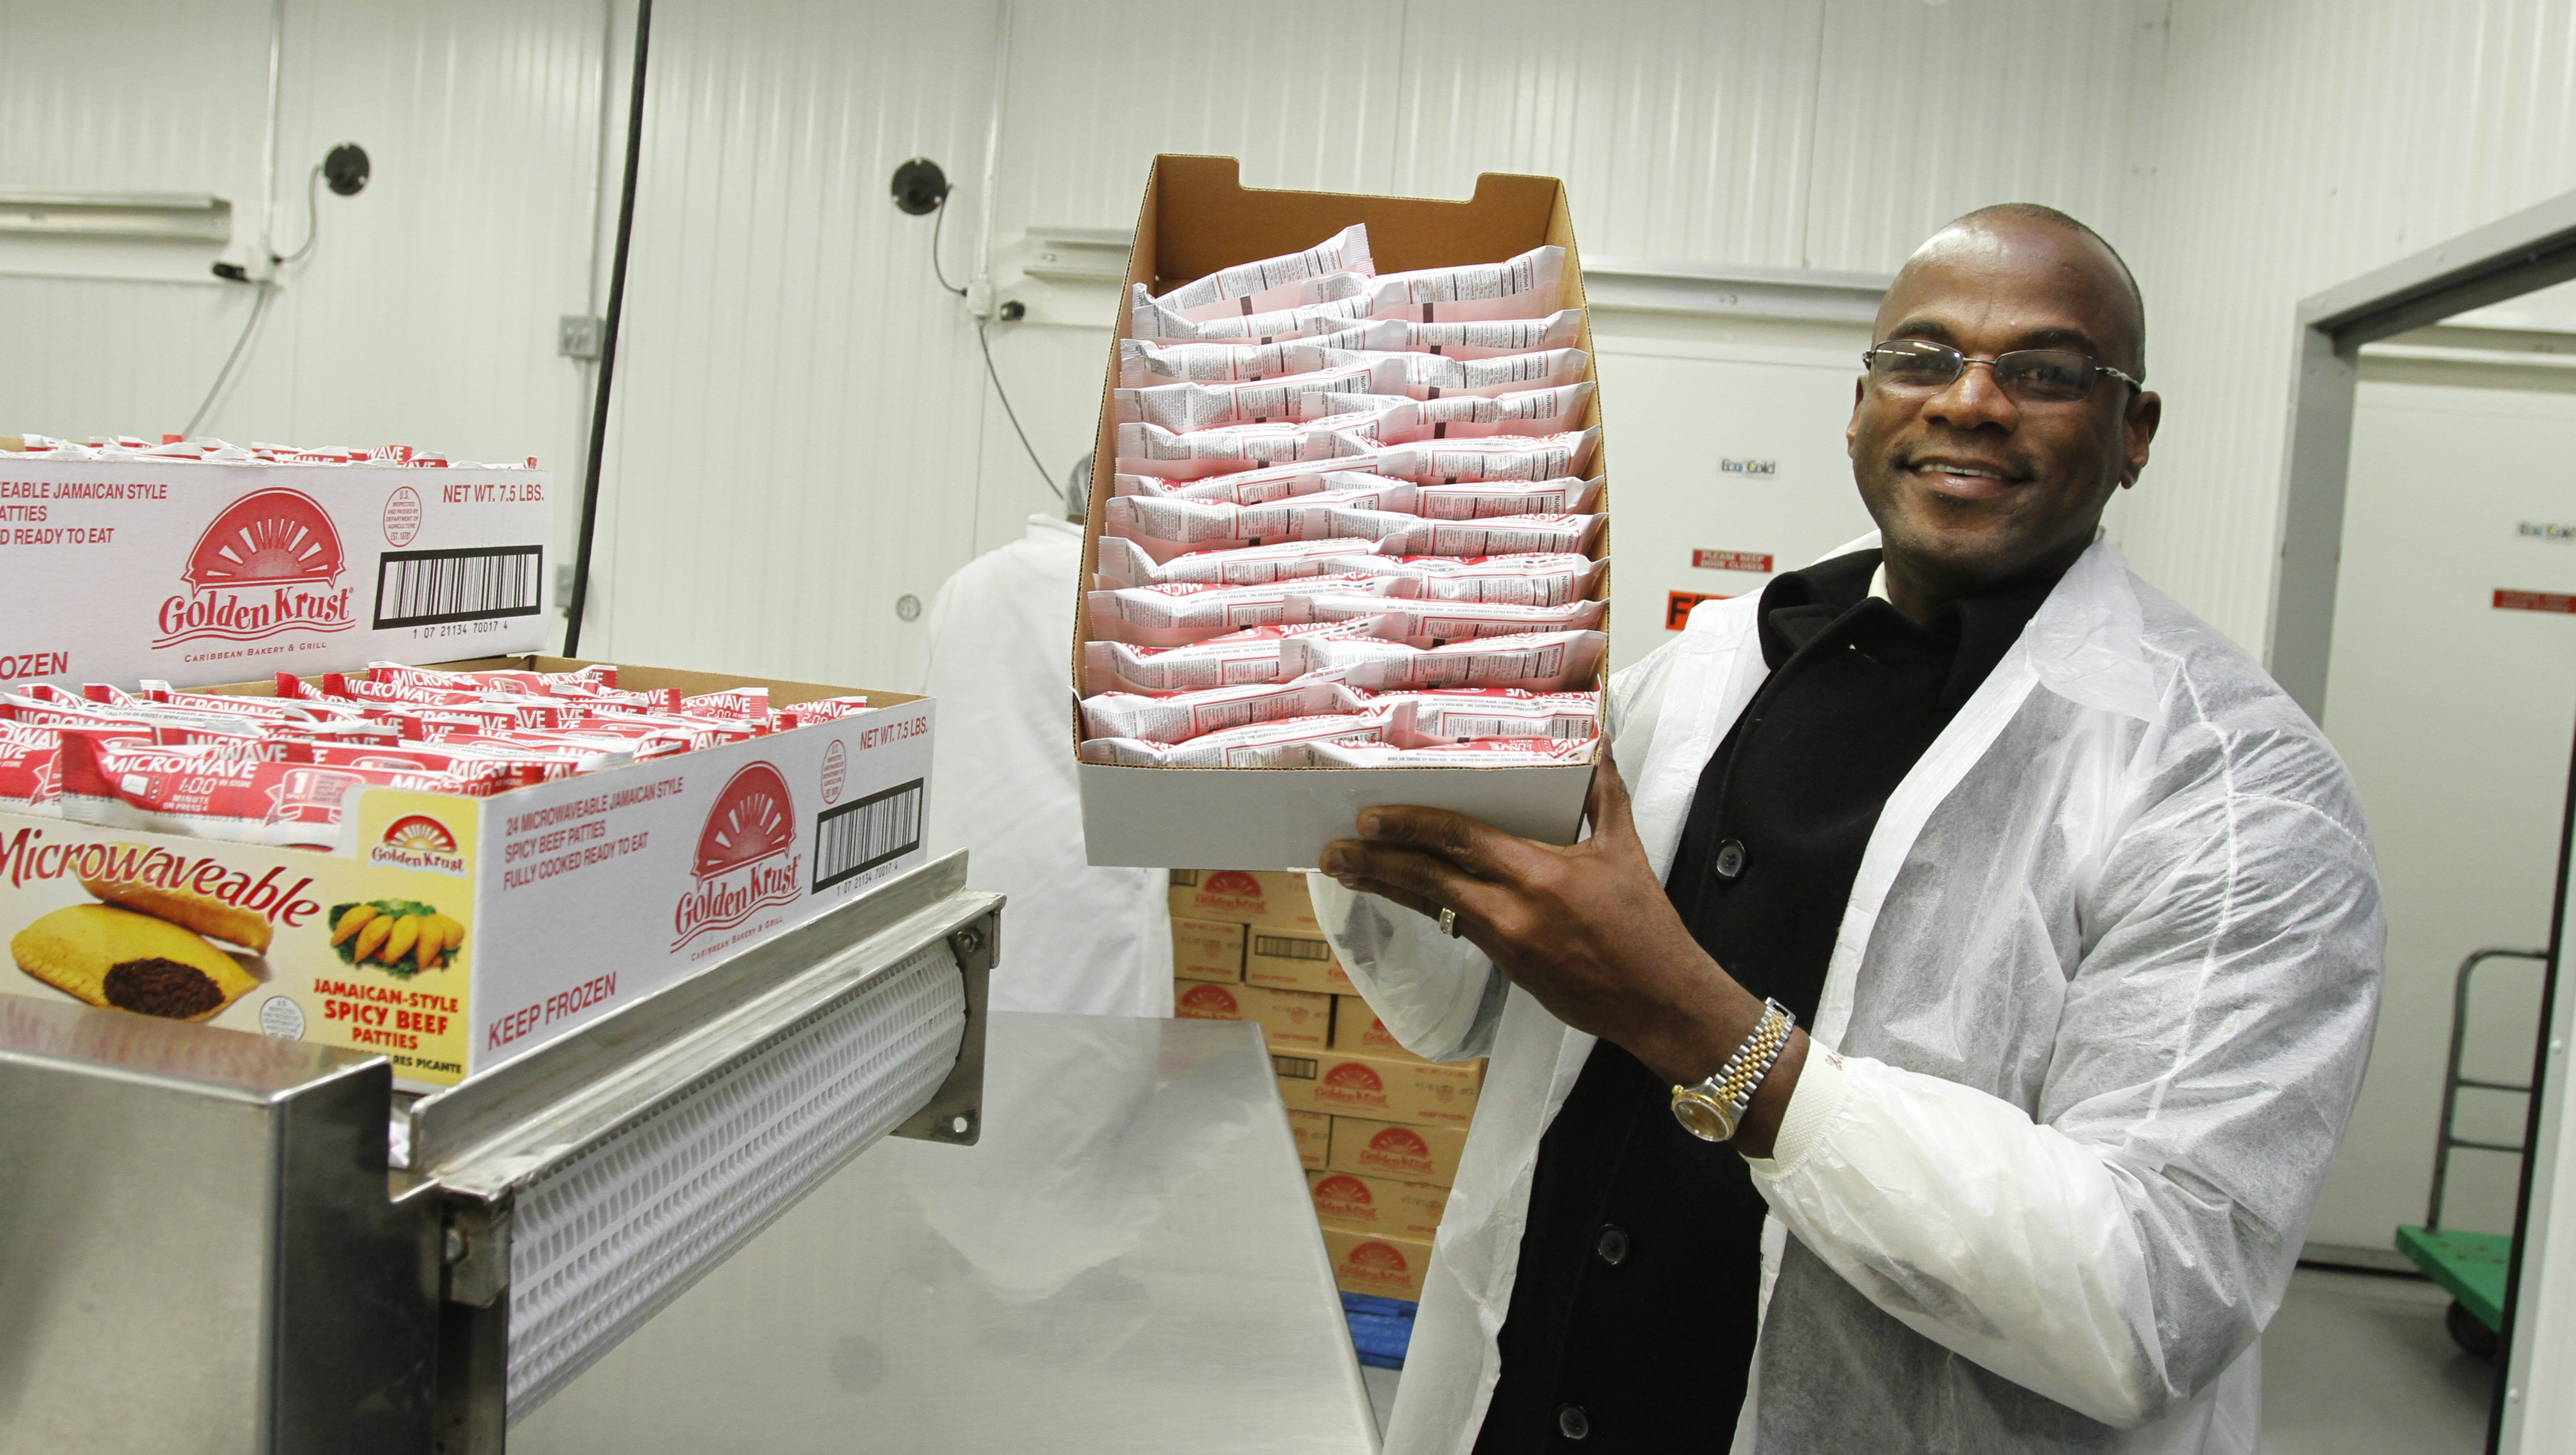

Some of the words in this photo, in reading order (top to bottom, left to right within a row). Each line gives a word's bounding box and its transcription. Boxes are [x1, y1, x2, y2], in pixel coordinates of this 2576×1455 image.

[0, 482, 49, 498] EABLE
[53, 483, 124, 499] JAMAICAN
[127, 484, 167, 499] STYLE
[443, 485, 471, 503] NET
[474, 485, 495, 502] WT.
[499, 485, 515, 502] 7.5
[519, 484, 544, 501] LBS.
[14, 528, 64, 545] READY
[67, 528, 85, 544] TO
[89, 528, 114, 543] EAT
[1702, 560, 1725, 569] DOOR
[1729, 562, 1764, 571] CLOSED
[1703, 551, 1736, 561] PLEASE
[159, 590, 270, 634] Golden
[274, 586, 350, 623] Krust
[413, 628, 417, 640] 1
[424, 627, 434, 639] 07
[440, 623, 467, 637] 21134
[473, 620, 498, 634] 70017
[503, 620, 508, 631] 4
[185, 650, 242, 663] CARIBBEAN
[247, 646, 284, 657] BAKERY
[299, 642, 326, 651] GRILL
[344, 677, 447, 706] MICROWAVE
[860, 728, 879, 751] NET
[881, 724, 895, 745] WT.
[897, 721, 909, 740] 7.5
[911, 716, 928, 737] LBS.
[102, 755, 260, 779] MICROWAVE
[179, 776, 217, 795] 1:00
[229, 780, 251, 788] STORE
[163, 802, 175, 810] OR
[176, 803, 202, 813] PRESS
[172, 794, 210, 804] MINUTE
[506, 817, 518, 837] 24
[521, 794, 608, 832] MICROWAVEABLE
[610, 783, 656, 810] JAMAICAN
[656, 776, 684, 798] STYLE
[505, 838, 537, 864] SPICY
[539, 830, 566, 854] BEEF
[568, 819, 607, 846] PATTIES
[372, 846, 421, 868] Golden
[423, 852, 464, 873] Krust
[504, 864, 536, 890] FULLY
[539, 851, 582, 880] COOKED
[584, 841, 616, 867] READY
[618, 836, 631, 856] TO
[631, 831, 649, 852] EAT
[0, 827, 321, 929] Microwaveable
[843, 880, 851, 894] 07
[675, 880, 747, 935] Golden
[749, 855, 799, 905] Krust
[691, 939, 729, 962] CARIBBEAN
[732, 927, 756, 944] BAKERY
[765, 916, 783, 929] GRILL
[313, 978, 458, 1013] JAMAICAN-STYLE
[324, 999, 389, 1027] SPICY
[396, 1010, 449, 1036] BEEF
[488, 1002, 541, 1052] KEEP
[545, 970, 617, 1025] FROZEN
[352, 1027, 418, 1051] PATTIES
[393, 1054, 413, 1067] RES
[416, 1058, 462, 1074] PICANTE
